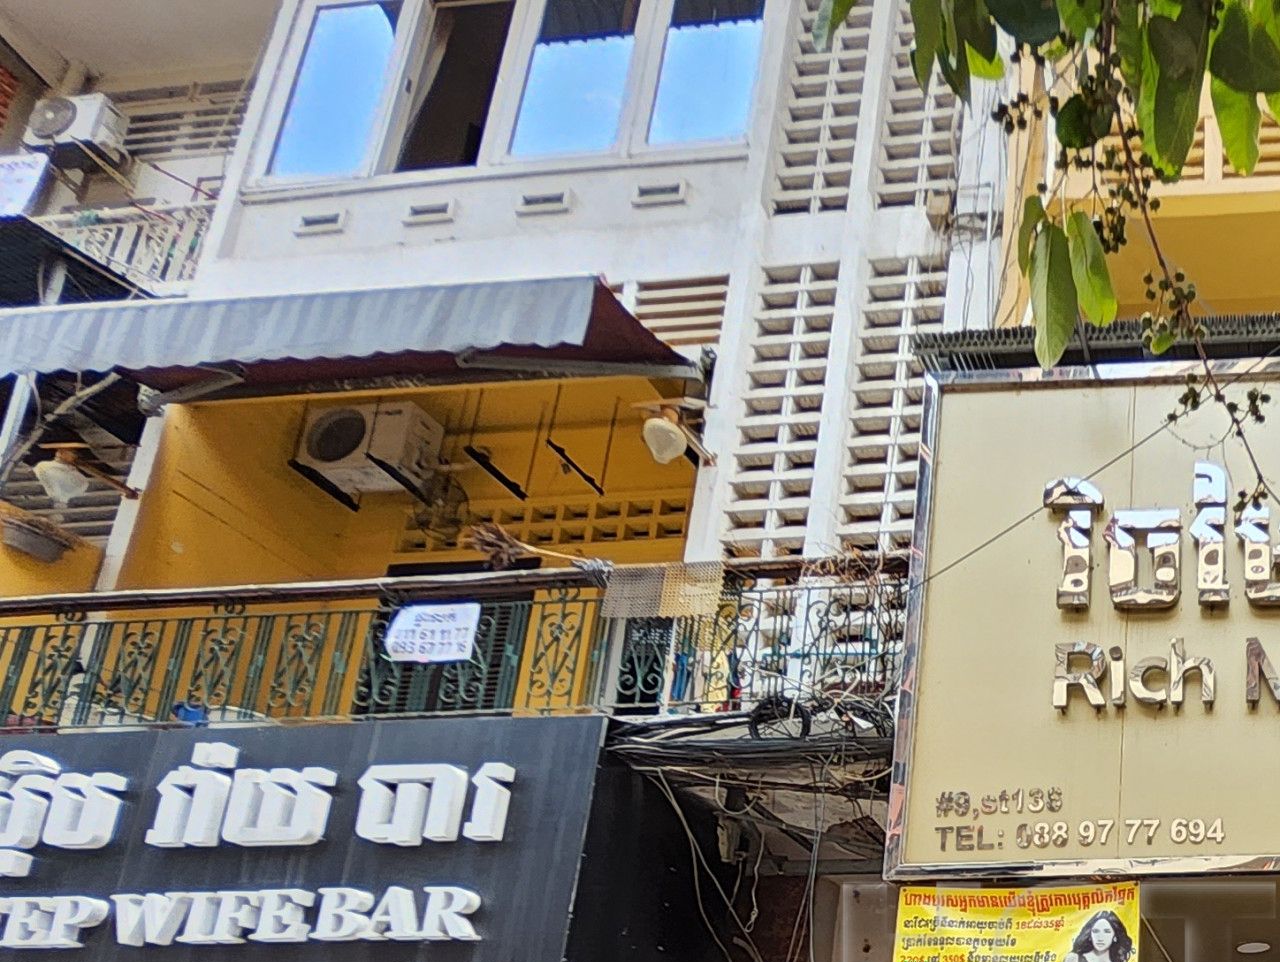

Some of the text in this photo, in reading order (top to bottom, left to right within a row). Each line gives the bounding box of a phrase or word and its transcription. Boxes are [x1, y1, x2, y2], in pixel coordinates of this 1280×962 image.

[1052, 637, 1216, 710] Rich
[935, 817, 1226, 852] TEL: 088 97 77 694
[0, 886, 483, 948] EP WIFE BAR
